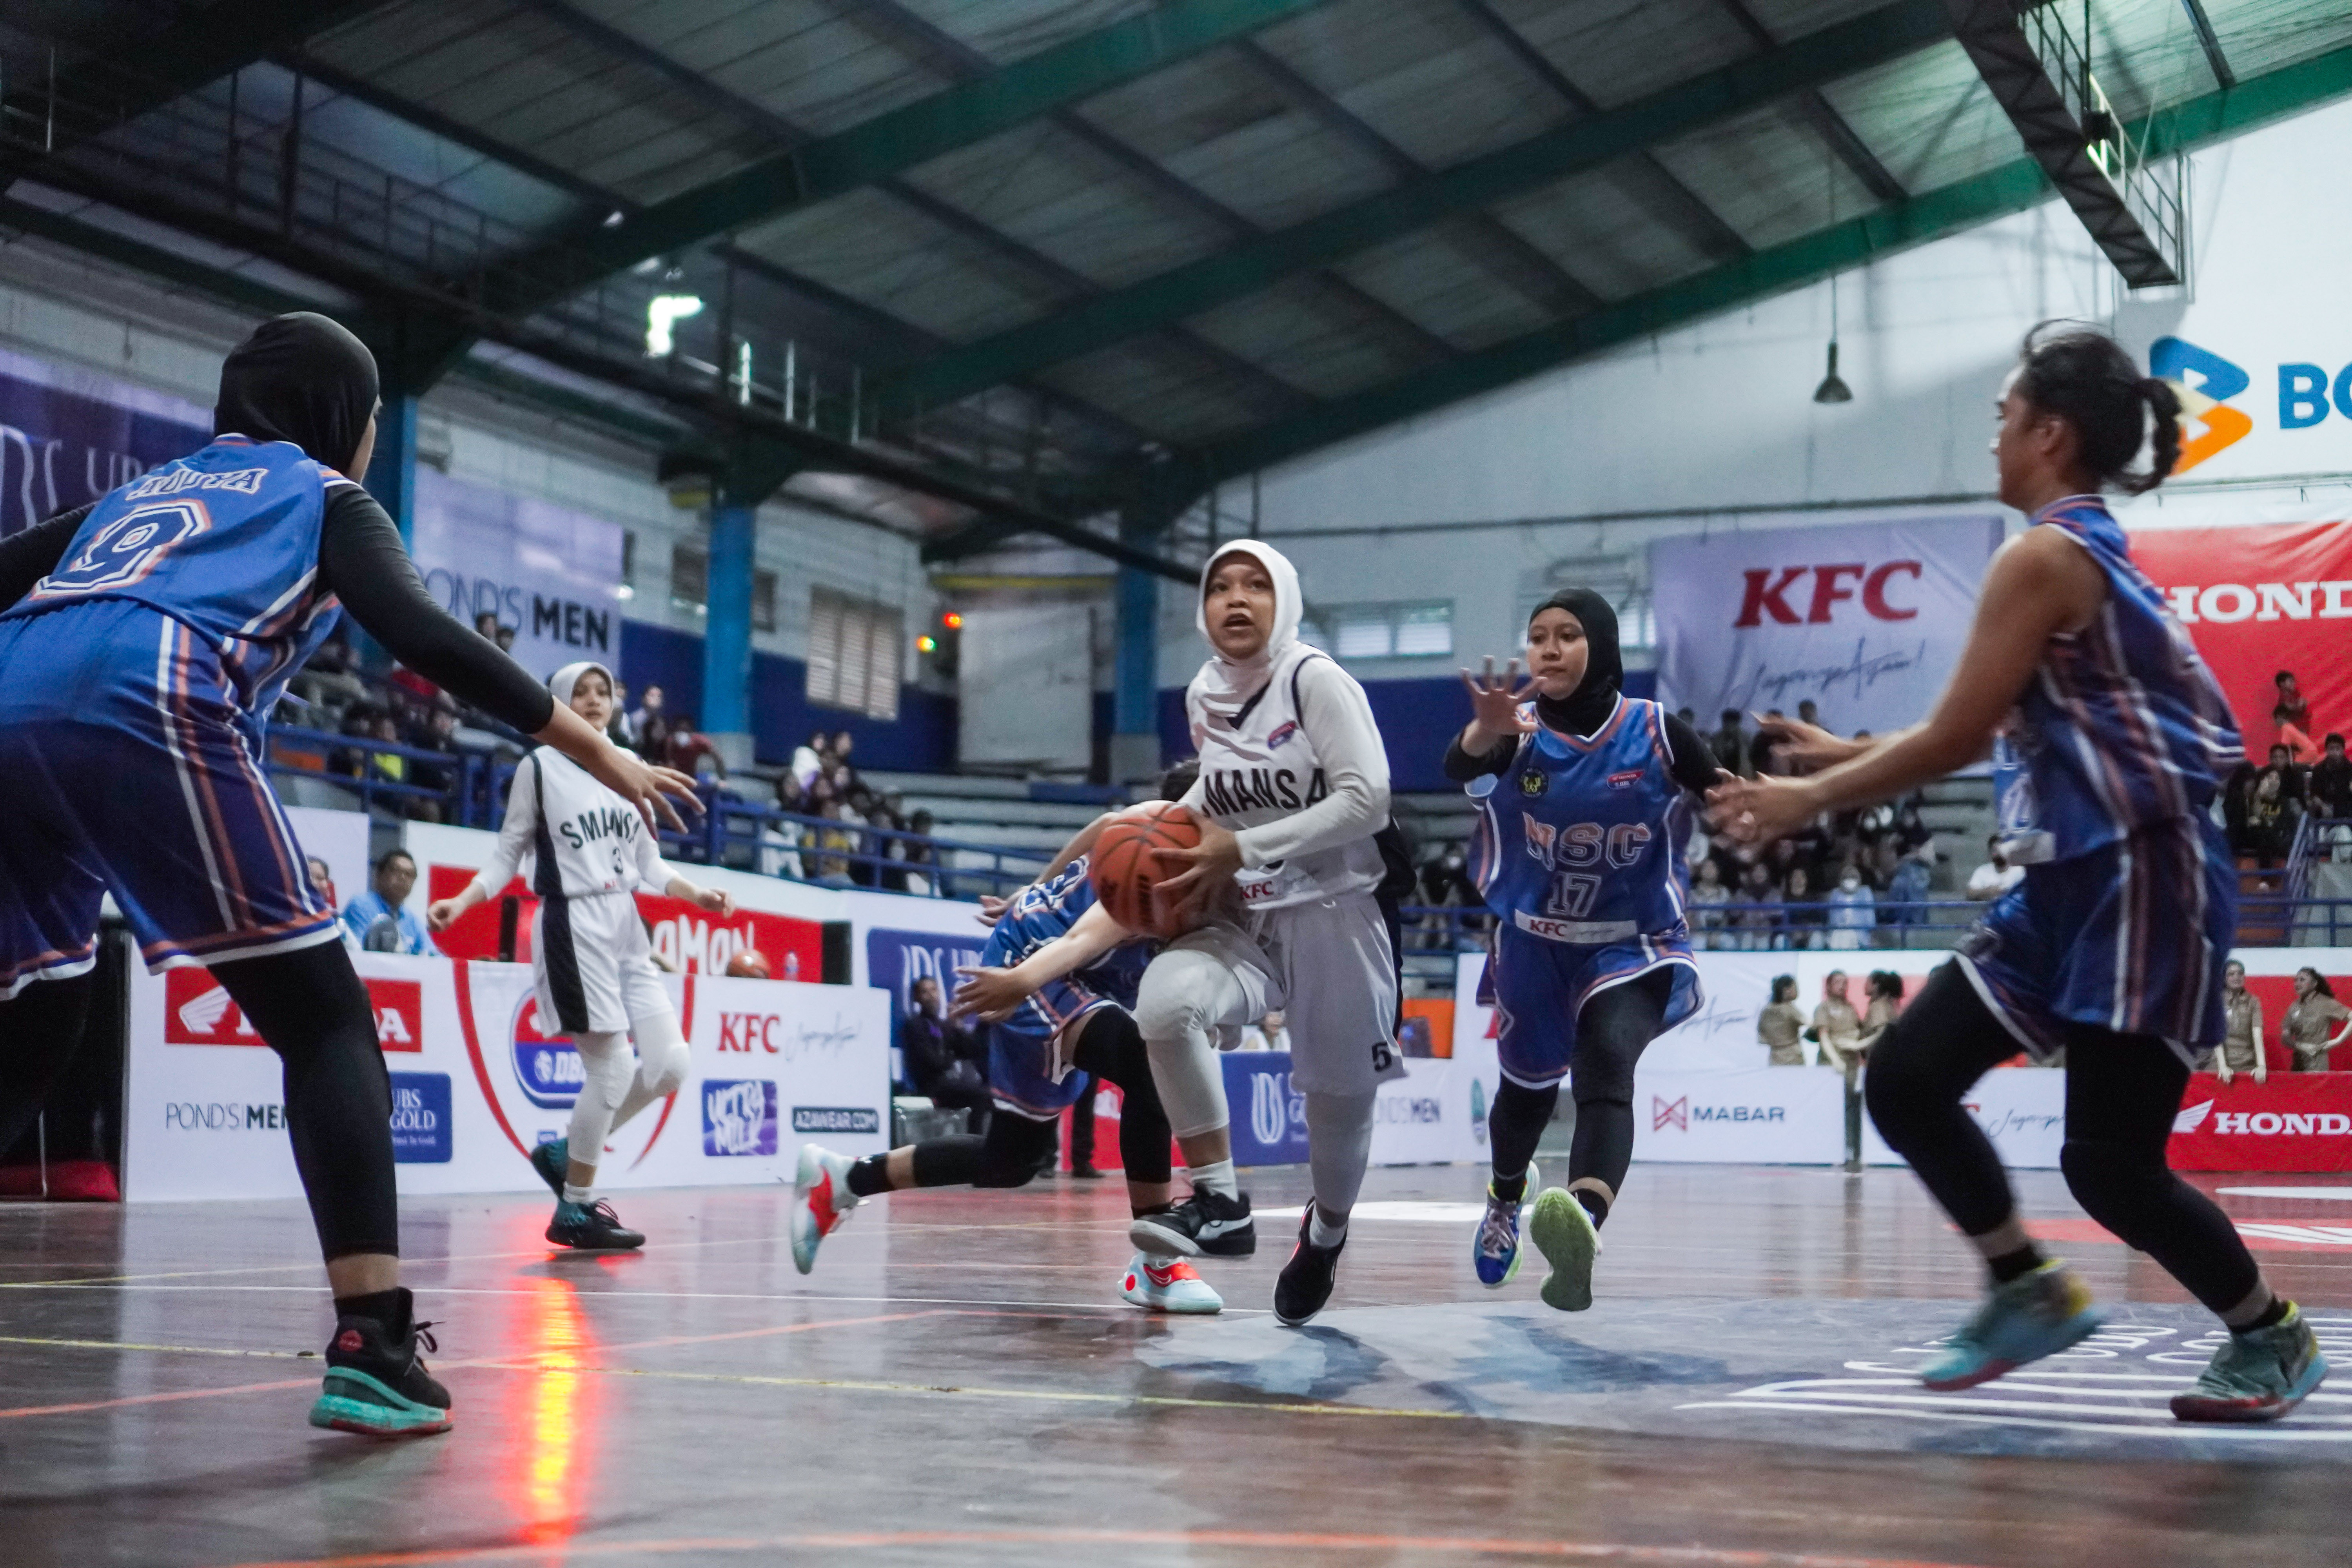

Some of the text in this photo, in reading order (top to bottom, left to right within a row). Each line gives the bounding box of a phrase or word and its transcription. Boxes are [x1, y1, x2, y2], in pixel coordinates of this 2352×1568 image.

[28, 499, 212, 601] 9
[1734, 559, 1922, 628] KFC
[414, 564, 609, 653] OND'S MEN
[1201, 767, 1328, 818] MANSA
[1240, 880, 1274, 901] KFC
[1548, 869, 1602, 917] 17
[1530, 919, 1568, 937] KFC
[717, 1011, 781, 1053] KFC
[1372, 1041, 1392, 1072] 5
[392, 1088, 421, 1109] UBS
[166, 1102, 239, 1129] POND'S
[389, 1109, 437, 1131] GOLD
[1693, 1106, 1785, 1122] MABAR
[2214, 1112, 2352, 1135] HOND
